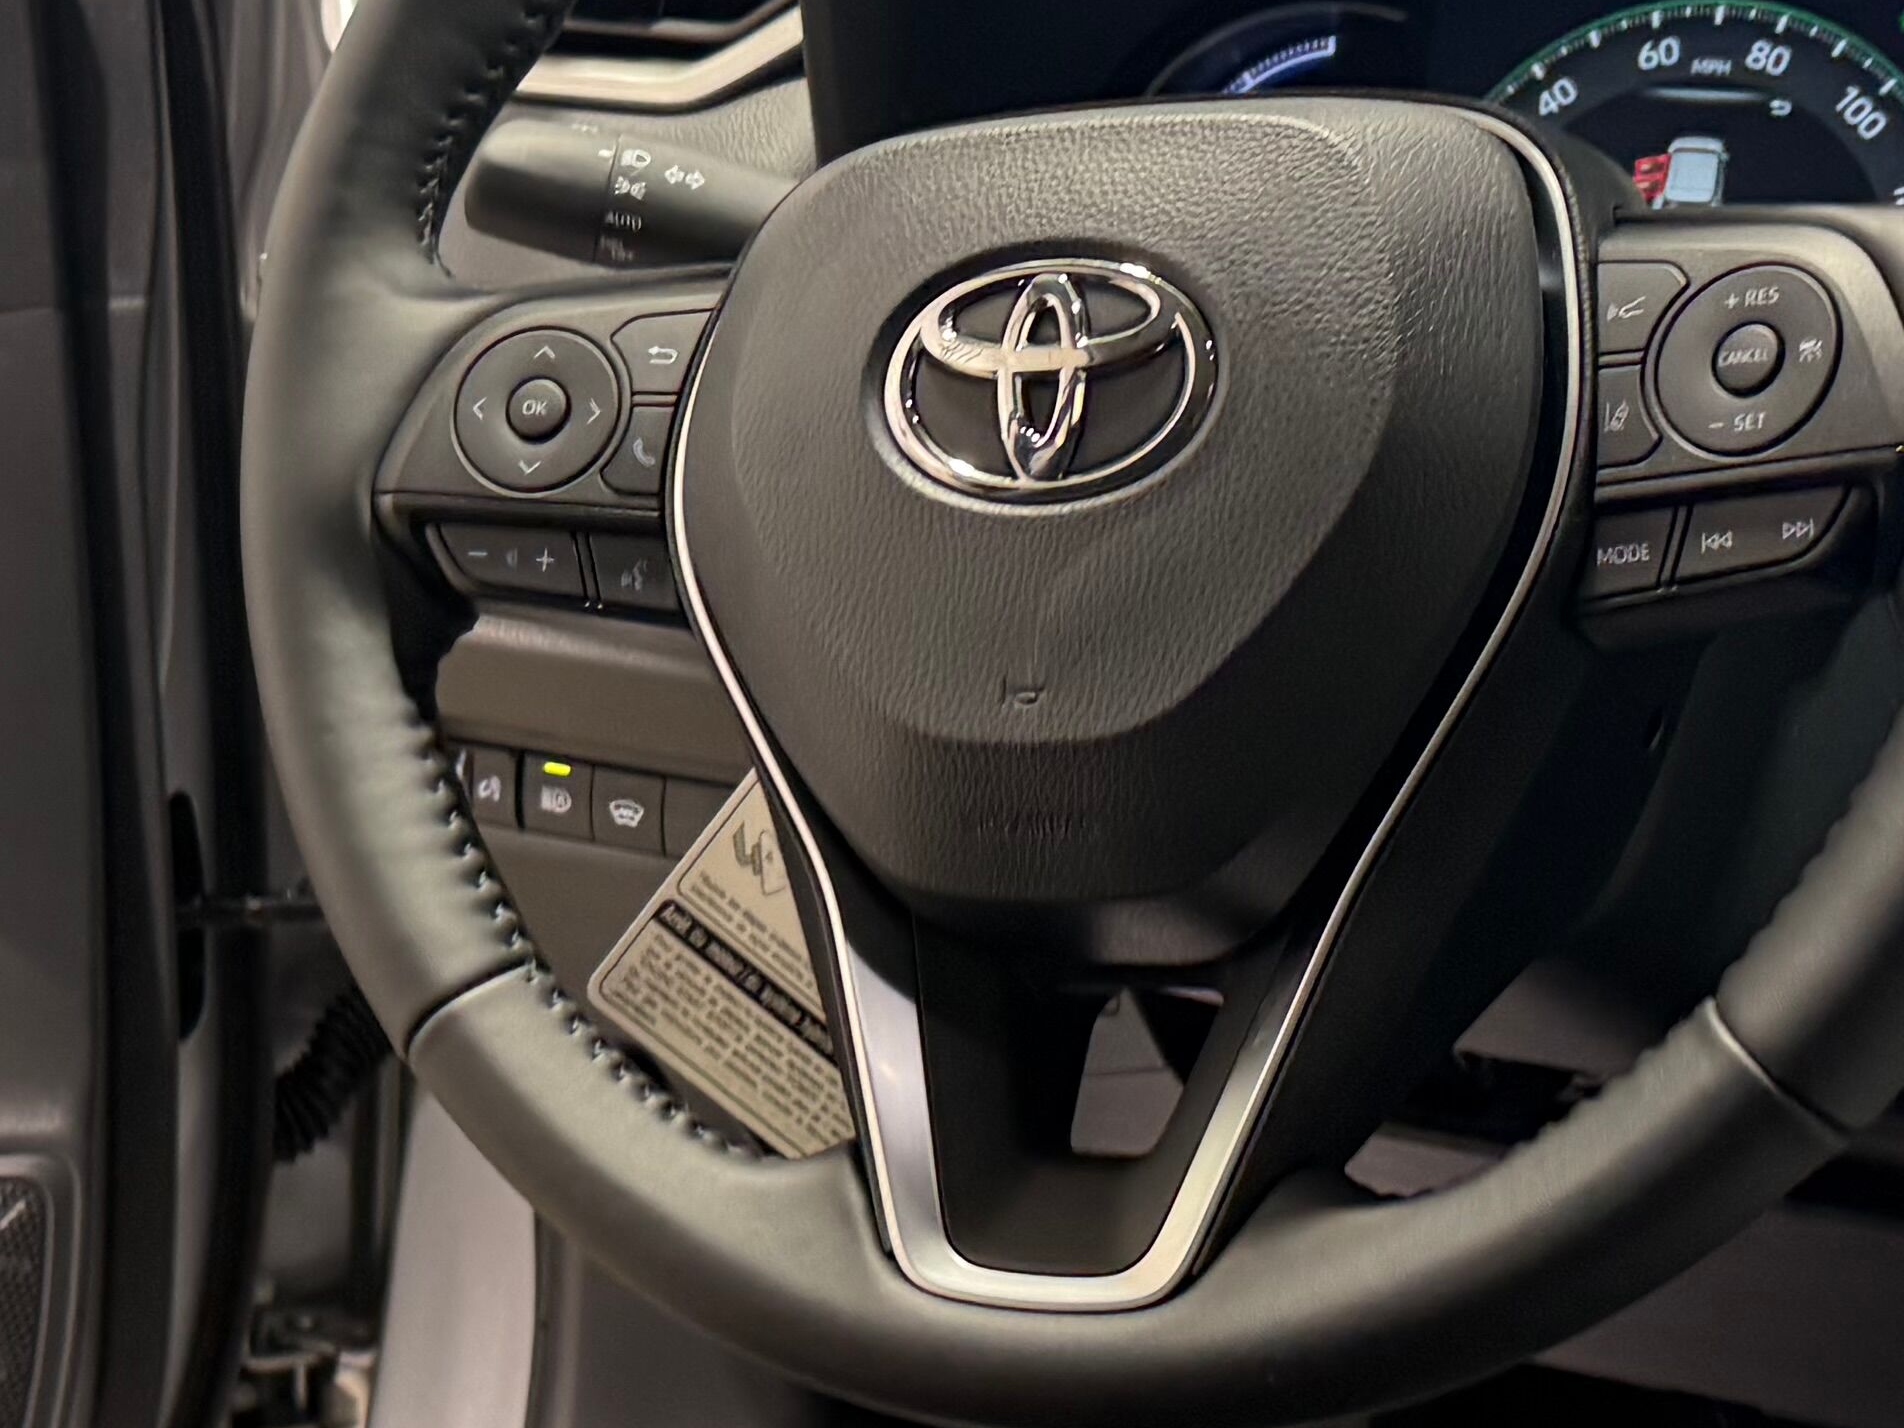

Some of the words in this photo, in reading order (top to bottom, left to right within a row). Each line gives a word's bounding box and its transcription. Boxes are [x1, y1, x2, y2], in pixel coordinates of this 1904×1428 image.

[1637, 38, 1681, 71] 60
[1744, 40, 1791, 76] 80
[1690, 58, 1732, 76] MPH
[1537, 76, 1579, 117] 40
[1834, 85, 1887, 141] 100
[1744, 286, 1780, 308] RES
[522, 399, 547, 416] OK
[1733, 413, 1766, 432] SET
[1596, 543, 1650, 566] MODE
